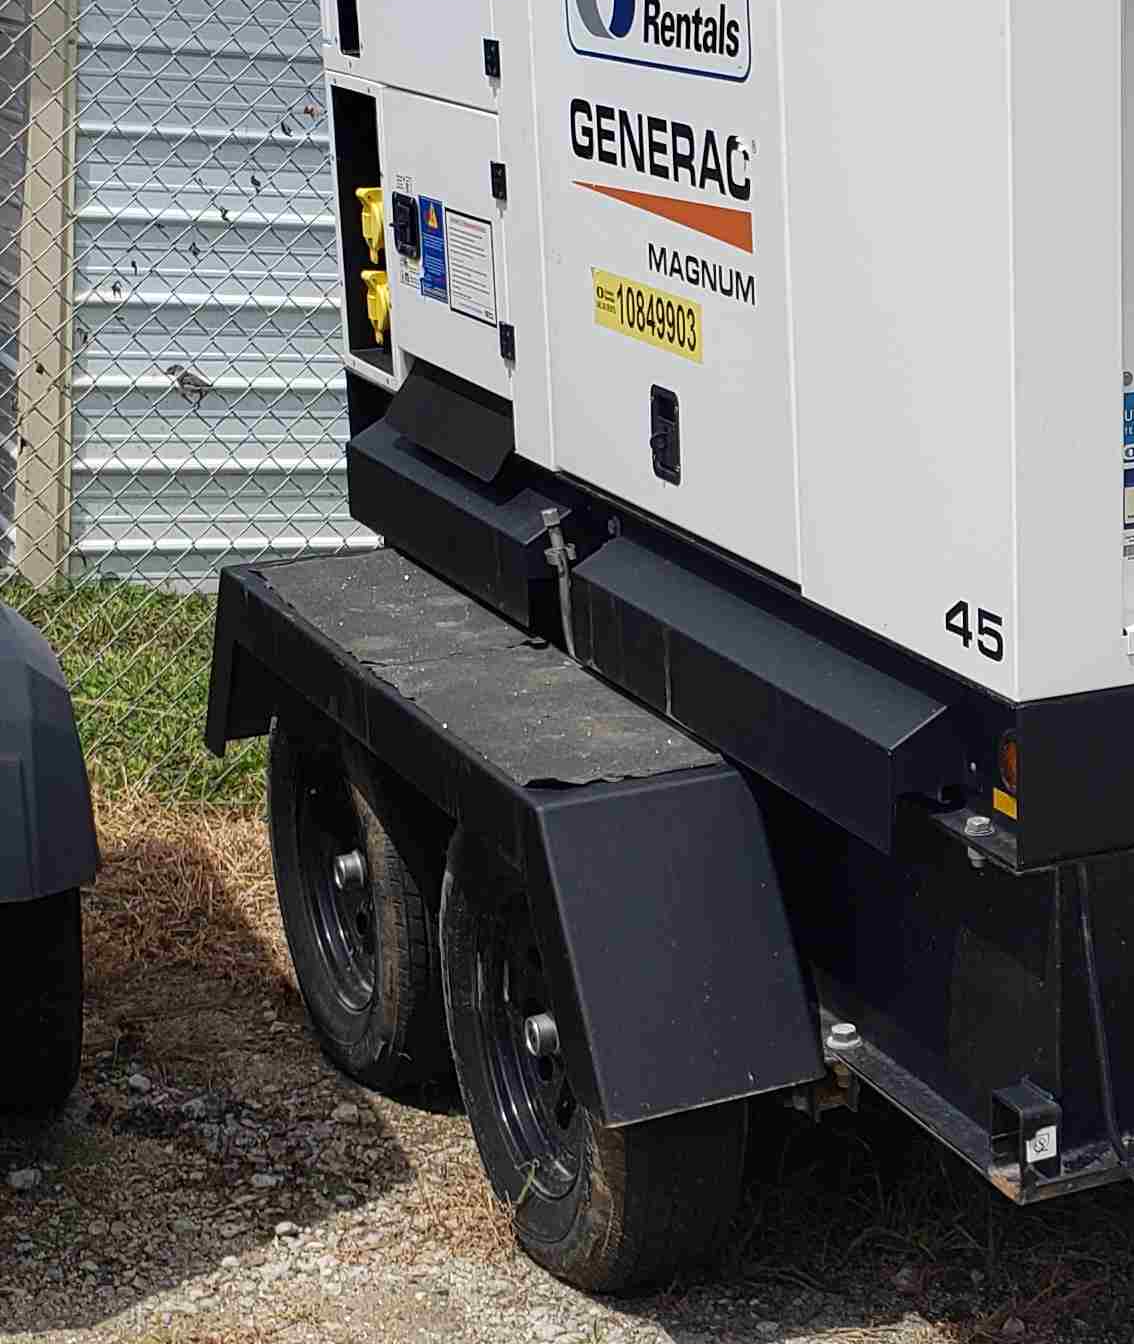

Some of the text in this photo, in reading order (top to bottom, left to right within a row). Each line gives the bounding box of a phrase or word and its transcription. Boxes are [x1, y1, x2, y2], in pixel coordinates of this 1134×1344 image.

[570, 97, 751, 201] GENERAC
[647, 242, 756, 306] MAGNUM
[616, 282, 697, 352] 10849903
[945, 600, 1004, 662] 45
